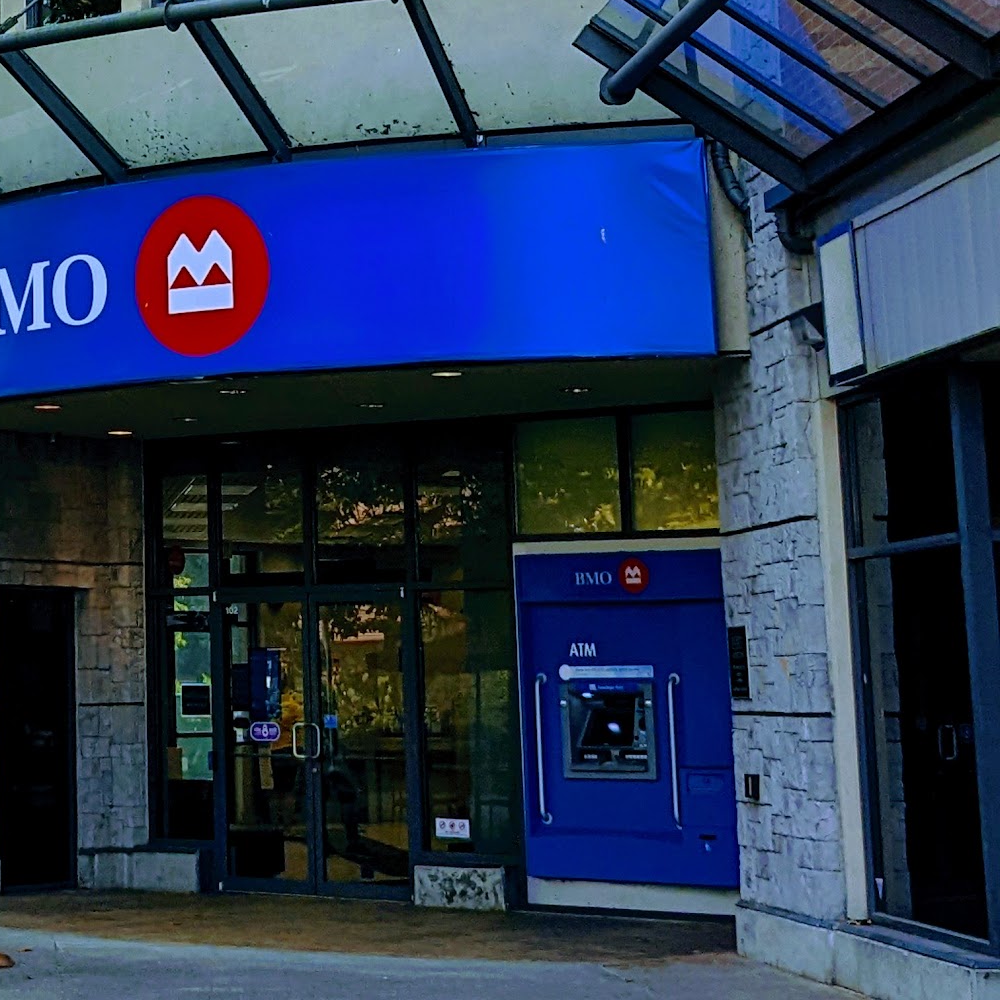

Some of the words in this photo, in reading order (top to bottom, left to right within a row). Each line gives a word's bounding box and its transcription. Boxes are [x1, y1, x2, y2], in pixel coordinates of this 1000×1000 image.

[575, 571, 612, 585] BMO
[225, 606, 239, 615] 102
[569, 642, 597, 657] ATM
